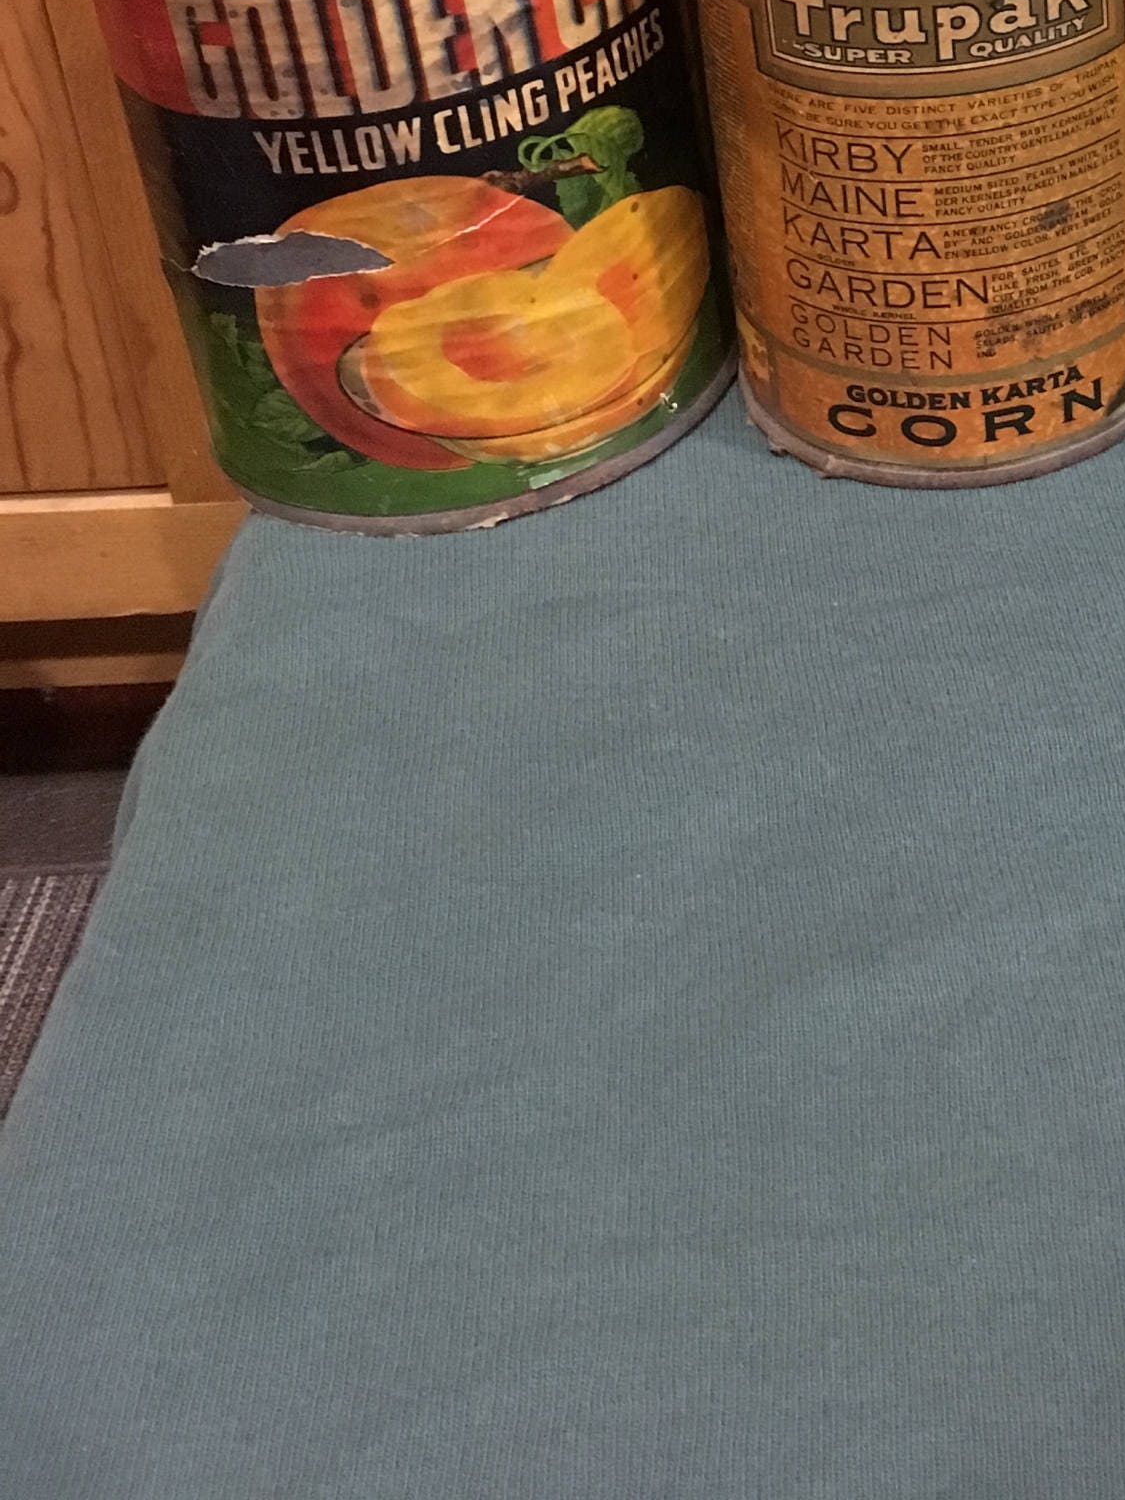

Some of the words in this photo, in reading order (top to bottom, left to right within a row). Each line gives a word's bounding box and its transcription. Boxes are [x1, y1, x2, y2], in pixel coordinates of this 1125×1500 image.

[802, 42, 913, 64] SUPER
[967, 14, 1089, 59] QUALITY
[252, 117, 422, 176] YELLOW
[432, 79, 550, 156] CLING
[555, 6, 665, 113] PEACHES
[806, 112, 821, 123] BE
[826, 115, 864, 129] SURE
[865, 120, 898, 131] YOU
[901, 119, 932, 131] GET
[933, 116, 967, 131] THE
[970, 107, 1019, 126] EXACT
[1021, 98, 1057, 115] TYPE
[1060, 88, 1087, 105] YOU
[808, 97, 835, 112] ARE
[844, 103, 876, 115] FIVE
[885, 103, 957, 117] DISTINCT
[967, 86, 1044, 111] VARIETIES
[774, 118, 914, 175] KIRBY
[940, 152, 964, 164] THE
[964, 143, 1019, 161] COUNTRY
[968, 133, 1014, 149] TENDER
[1020, 123, 1048, 139] BABY
[923, 163, 962, 175] FANCY
[966, 155, 1017, 171] QUALITY
[934, 183, 983, 197] MEDIUM
[987, 176, 1020, 190] SIZED
[935, 196, 959, 207] DER
[961, 187, 1013, 204] KERNELS
[1013, 177, 1055, 195] PACKED
[1067, 161, 1100, 179] MAINE
[779, 161, 926, 220] MAINE
[935, 206, 974, 217] FANCY
[977, 197, 1026, 213] QUALITY
[783, 204, 945, 261] KARTA
[784, 256, 990, 311] GARDEN
[790, 302, 952, 348] GOLDEN
[791, 325, 953, 372] GARDEN
[845, 383, 972, 411] GOLDEN
[979, 364, 1085, 407] KARTA
[827, 377, 1105, 448] CORN
